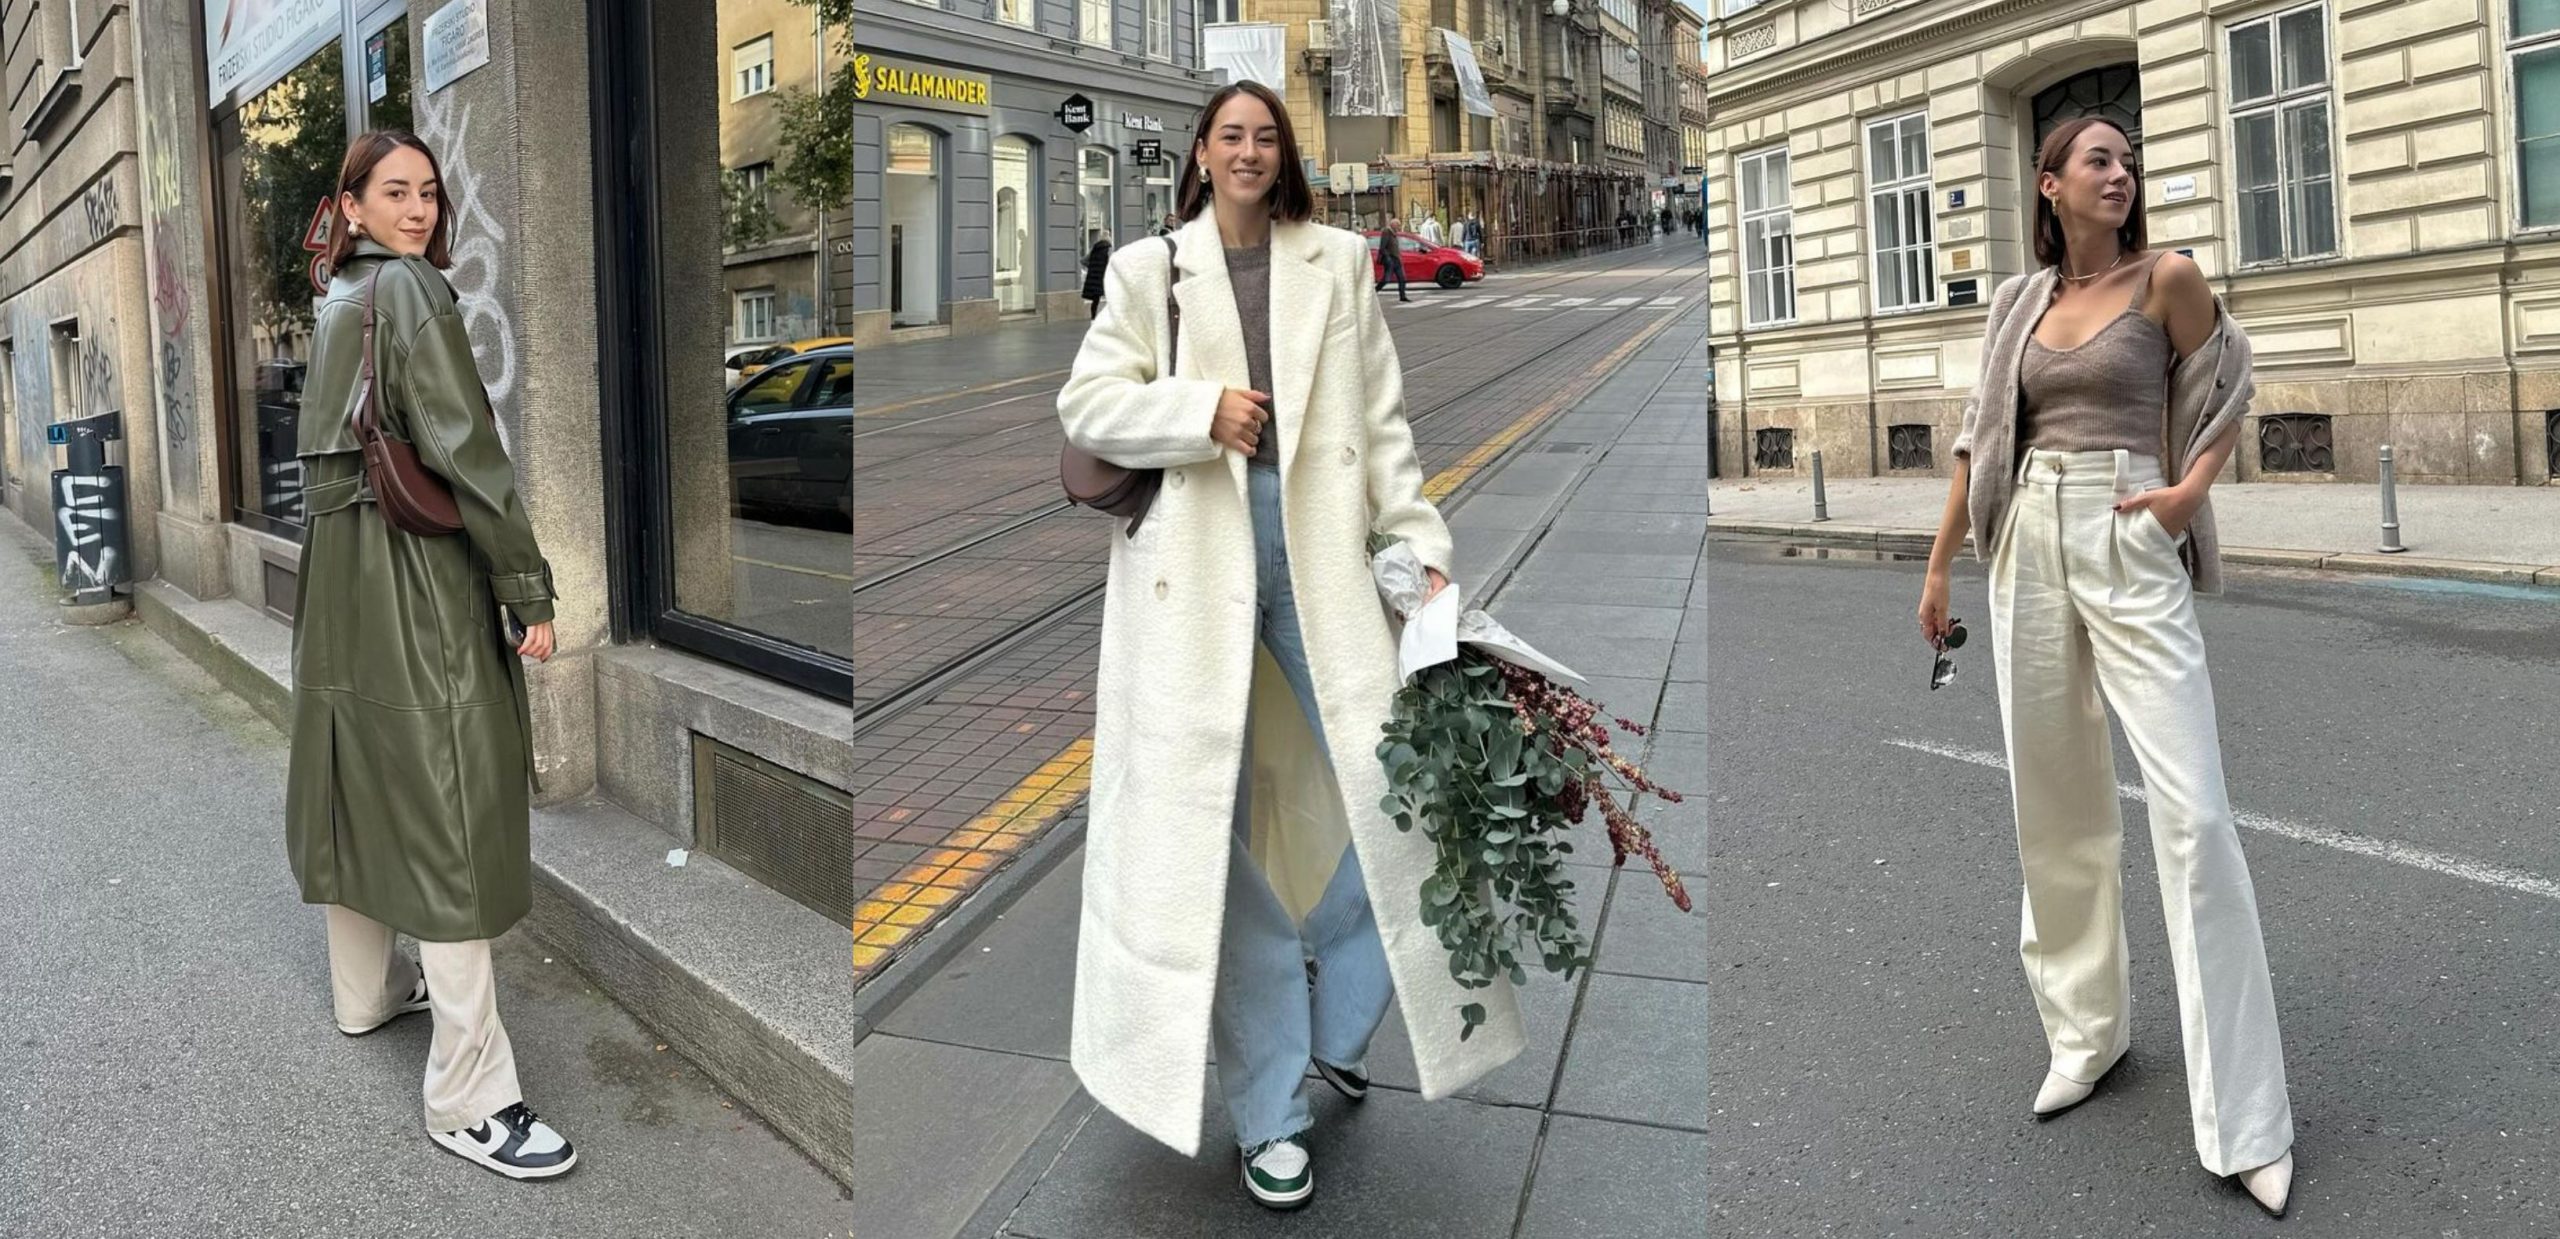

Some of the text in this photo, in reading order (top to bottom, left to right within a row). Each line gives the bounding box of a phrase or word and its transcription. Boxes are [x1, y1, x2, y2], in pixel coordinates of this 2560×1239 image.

[253, 15, 285, 58] STUDIO
[875, 66, 987, 105] SALAMANDER
[1065, 104, 1087, 114] Kent
[1065, 114, 1091, 124] Bank
[1124, 112, 1163, 132] Kent Bank
